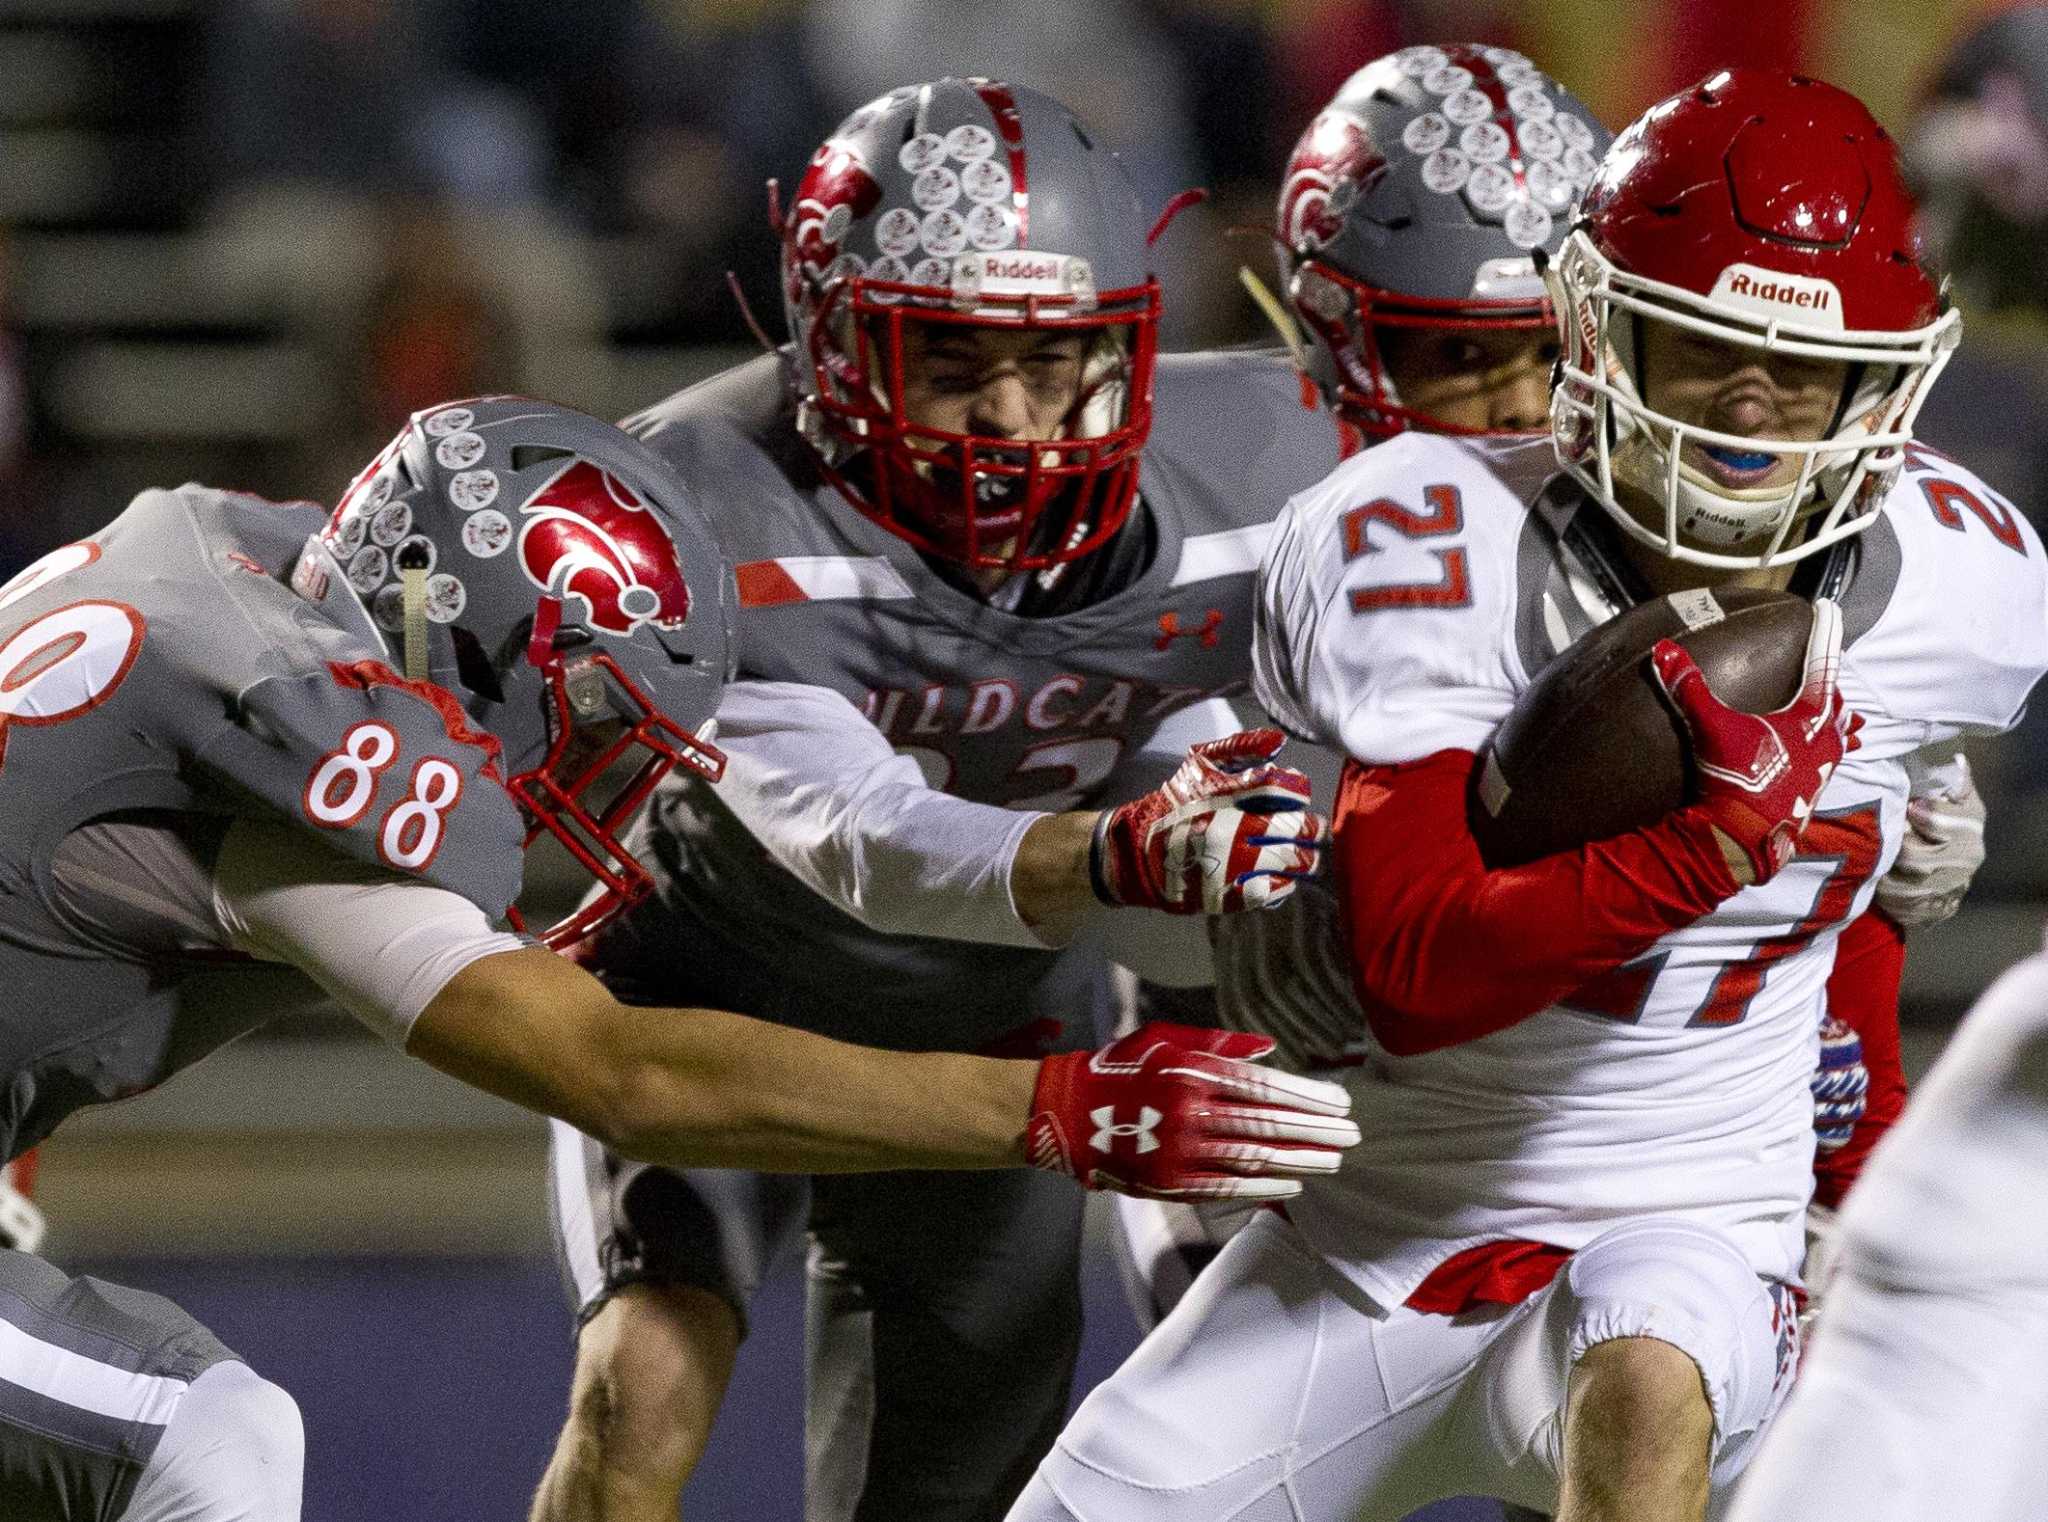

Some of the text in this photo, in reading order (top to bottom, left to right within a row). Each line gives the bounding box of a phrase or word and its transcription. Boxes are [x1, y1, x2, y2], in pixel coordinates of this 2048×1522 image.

[985, 258, 1058, 280] Riddell
[1730, 273, 1829, 311] Riddell
[1694, 507, 1746, 528] Riddell
[1337, 483, 1475, 617] 27
[865, 673, 1250, 736] ILDCAT
[303, 717, 464, 876] 88
